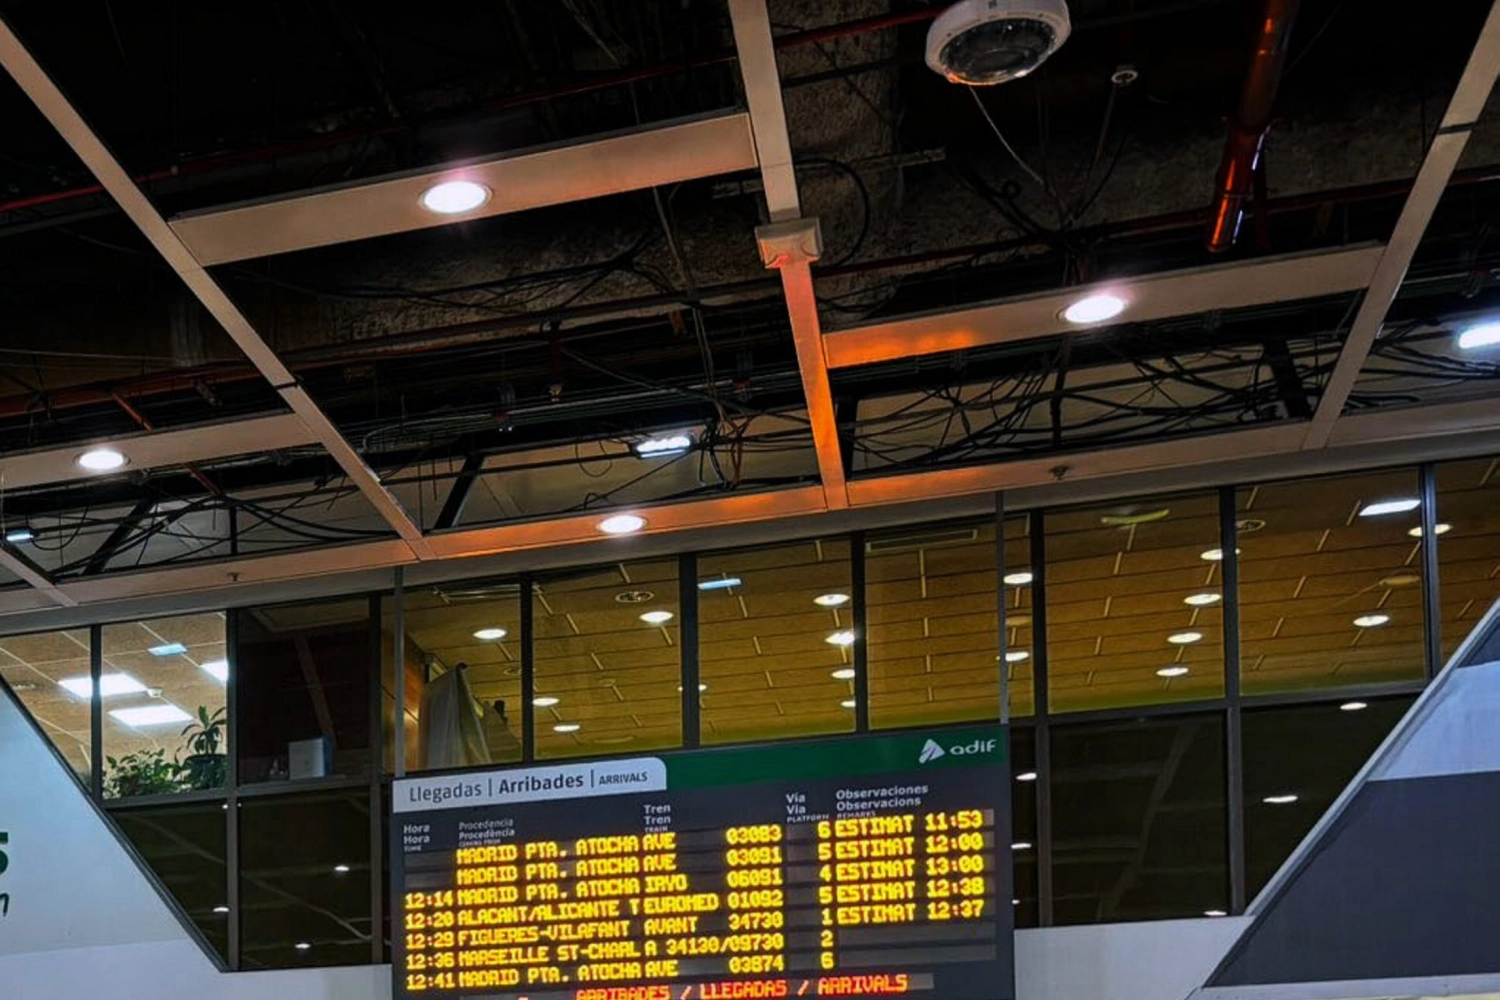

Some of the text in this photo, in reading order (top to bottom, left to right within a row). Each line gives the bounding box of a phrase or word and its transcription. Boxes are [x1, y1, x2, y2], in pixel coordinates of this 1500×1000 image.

[950, 740, 996, 756] adif
[410, 771, 648, 804] Llegadas Arribades ARRIVALS
[836, 784, 929, 801] Observaciones
[644, 804, 671, 815] Tren
[836, 796, 921, 812] Observacions
[403, 824, 431, 835] Hora
[458, 817, 514, 832] Procedencia
[644, 815, 671, 826] Tren
[403, 835, 431, 846] Hora
[456, 809, 983, 866] MADRID PTA. ATOCHA AVE 03083 6 ESTIMAT 11:53
[458, 826, 516, 842] Procedència
[456, 831, 984, 885] MADRID PTA. ATOCHA AVE 03091 5 ESTIMAT 12:00
[405, 890, 454, 909] 12:14
[457, 885, 519, 906] MADRID
[525, 882, 568, 901] PTA.
[575, 877, 641, 899] ATOCHA
[819, 864, 832, 882] 4
[835, 858, 916, 882] ESTIMAT
[926, 854, 984, 877] 13:00
[405, 910, 455, 930] 12:20
[457, 899, 620, 926] ALACANT/ALICANTE
[628, 898, 640, 915] T
[643, 893, 720, 915] EUROMED
[818, 885, 833, 904] 5
[836, 880, 916, 903] ESTIMAT
[926, 876, 985, 899] 12:38
[406, 899, 985, 949] 12:29 FIGUERES-VILAFANT AVANT 34730 1 ESTIMAT 12:37
[406, 929, 833, 970] 12:36 MARSEILLE ST-CHARL A 34130/09730 2
[406, 951, 834, 991] 12:41 MADRID PTA. ATOCHA AVE 03874 6
[699, 979, 787, 1000] LLEGADAS
[818, 973, 909, 996] ARRIVALS
